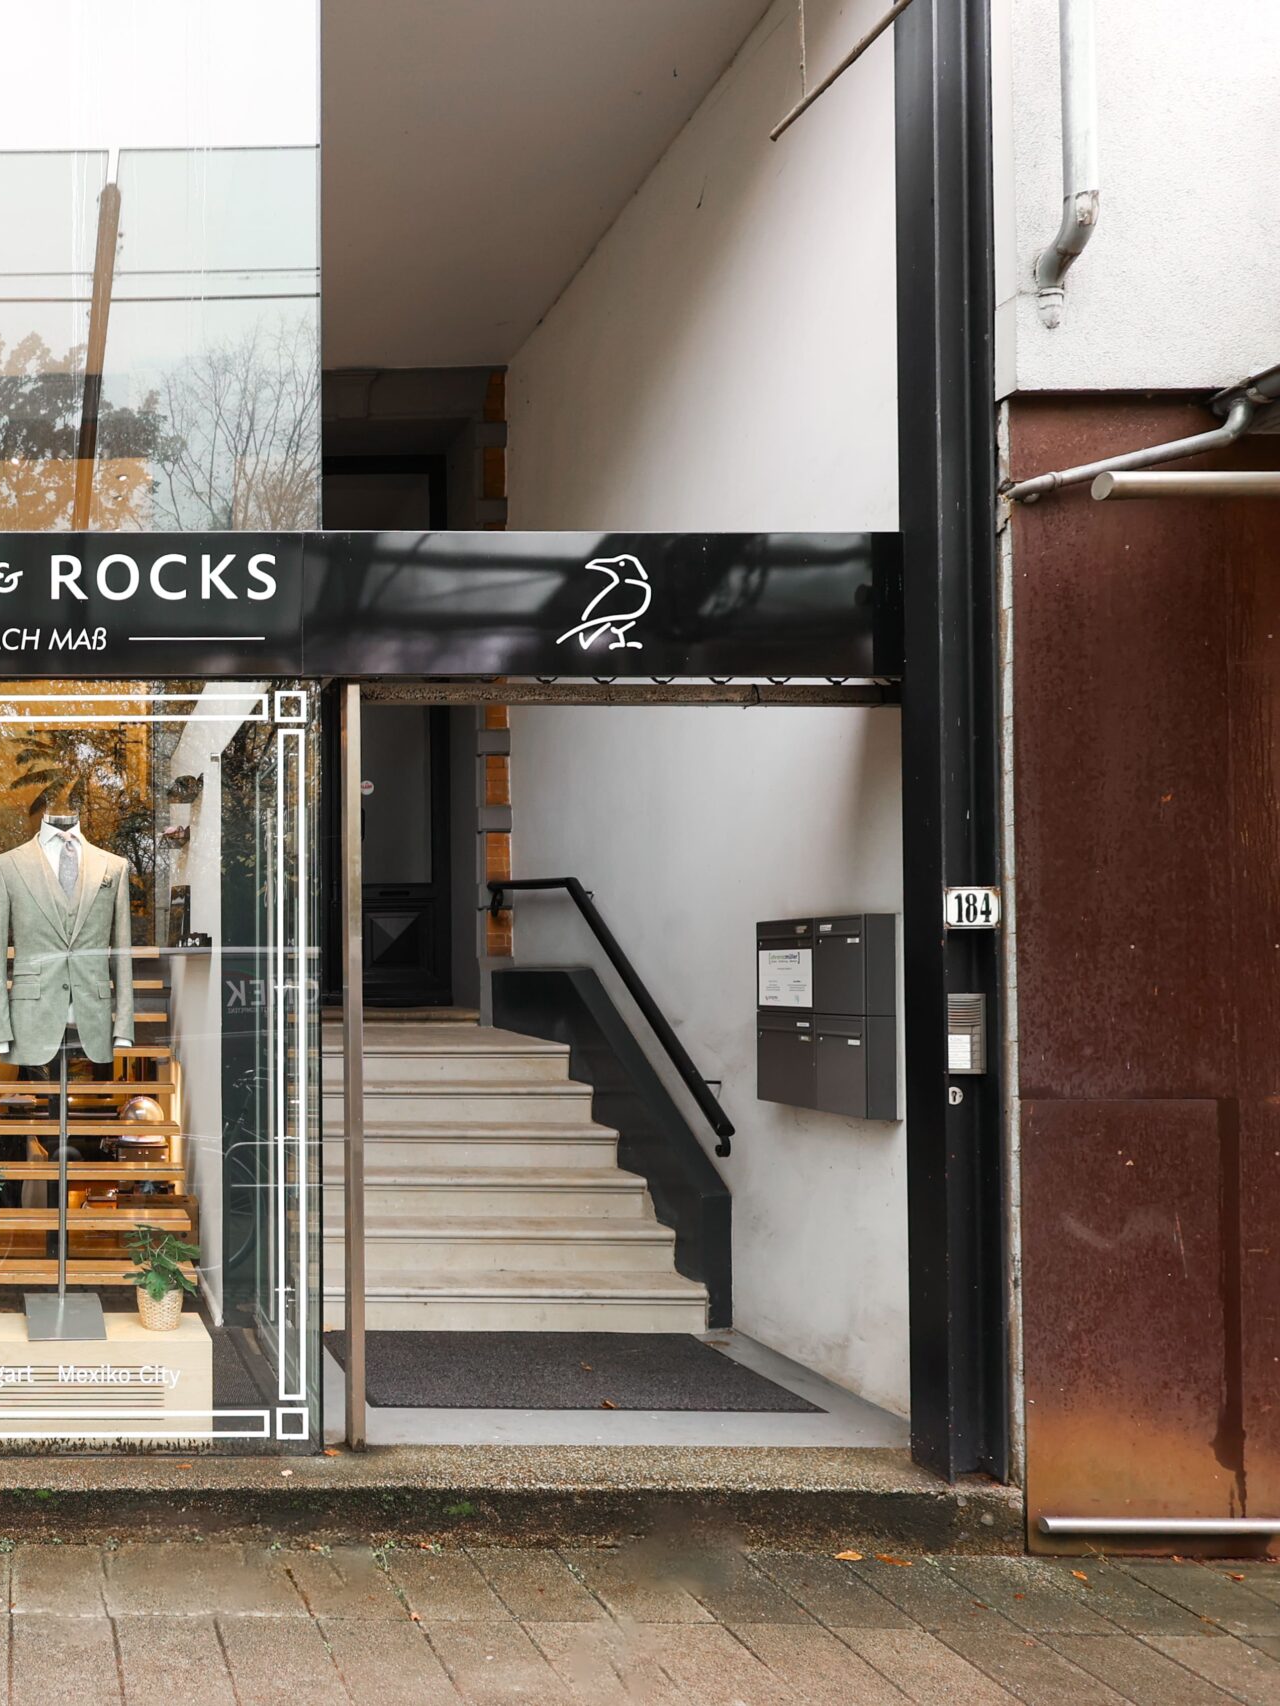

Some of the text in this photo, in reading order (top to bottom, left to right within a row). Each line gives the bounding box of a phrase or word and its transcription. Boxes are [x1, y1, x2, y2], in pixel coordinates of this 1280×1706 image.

[50, 553, 278, 602] ROCKS
[954, 892, 992, 924] 184
[57, 1363, 132, 1384] Mexiko
[139, 1364, 181, 1389] City
